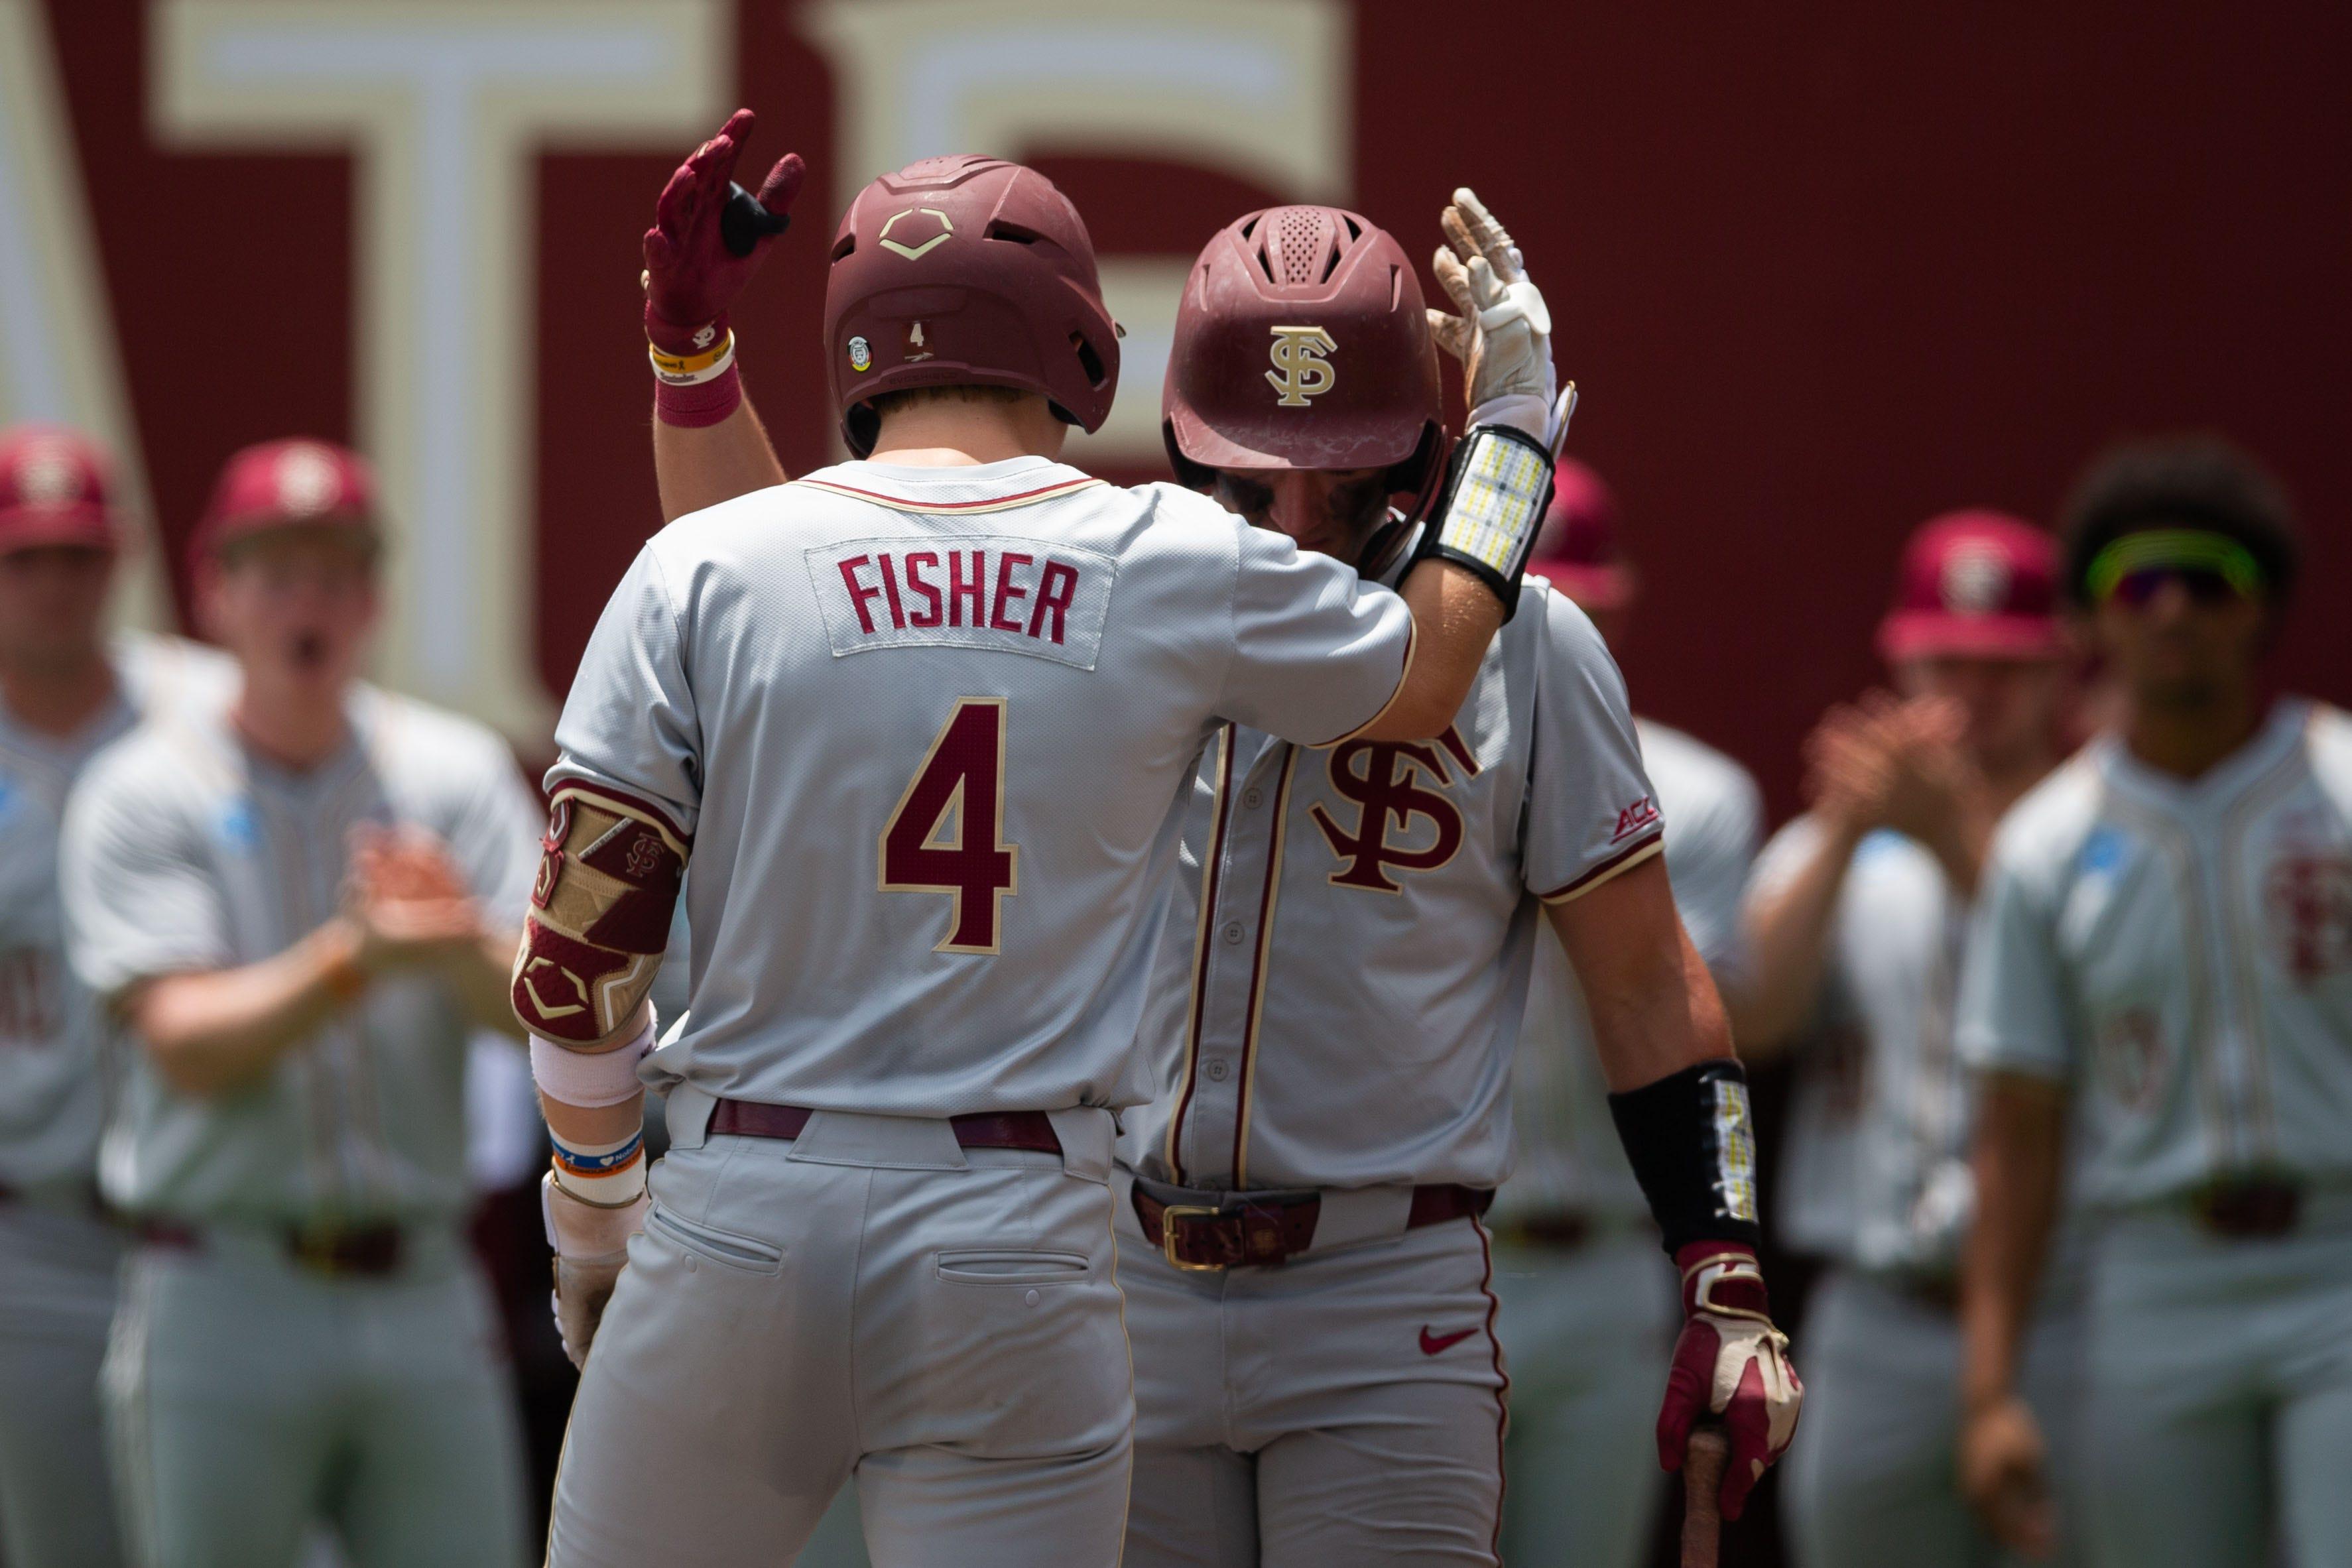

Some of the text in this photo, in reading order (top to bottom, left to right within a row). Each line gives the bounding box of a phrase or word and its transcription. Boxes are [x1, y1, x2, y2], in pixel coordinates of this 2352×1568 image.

[910, 323, 924, 347] 4
[838, 550, 1079, 644] FISHER
[878, 696, 1019, 955] 4
